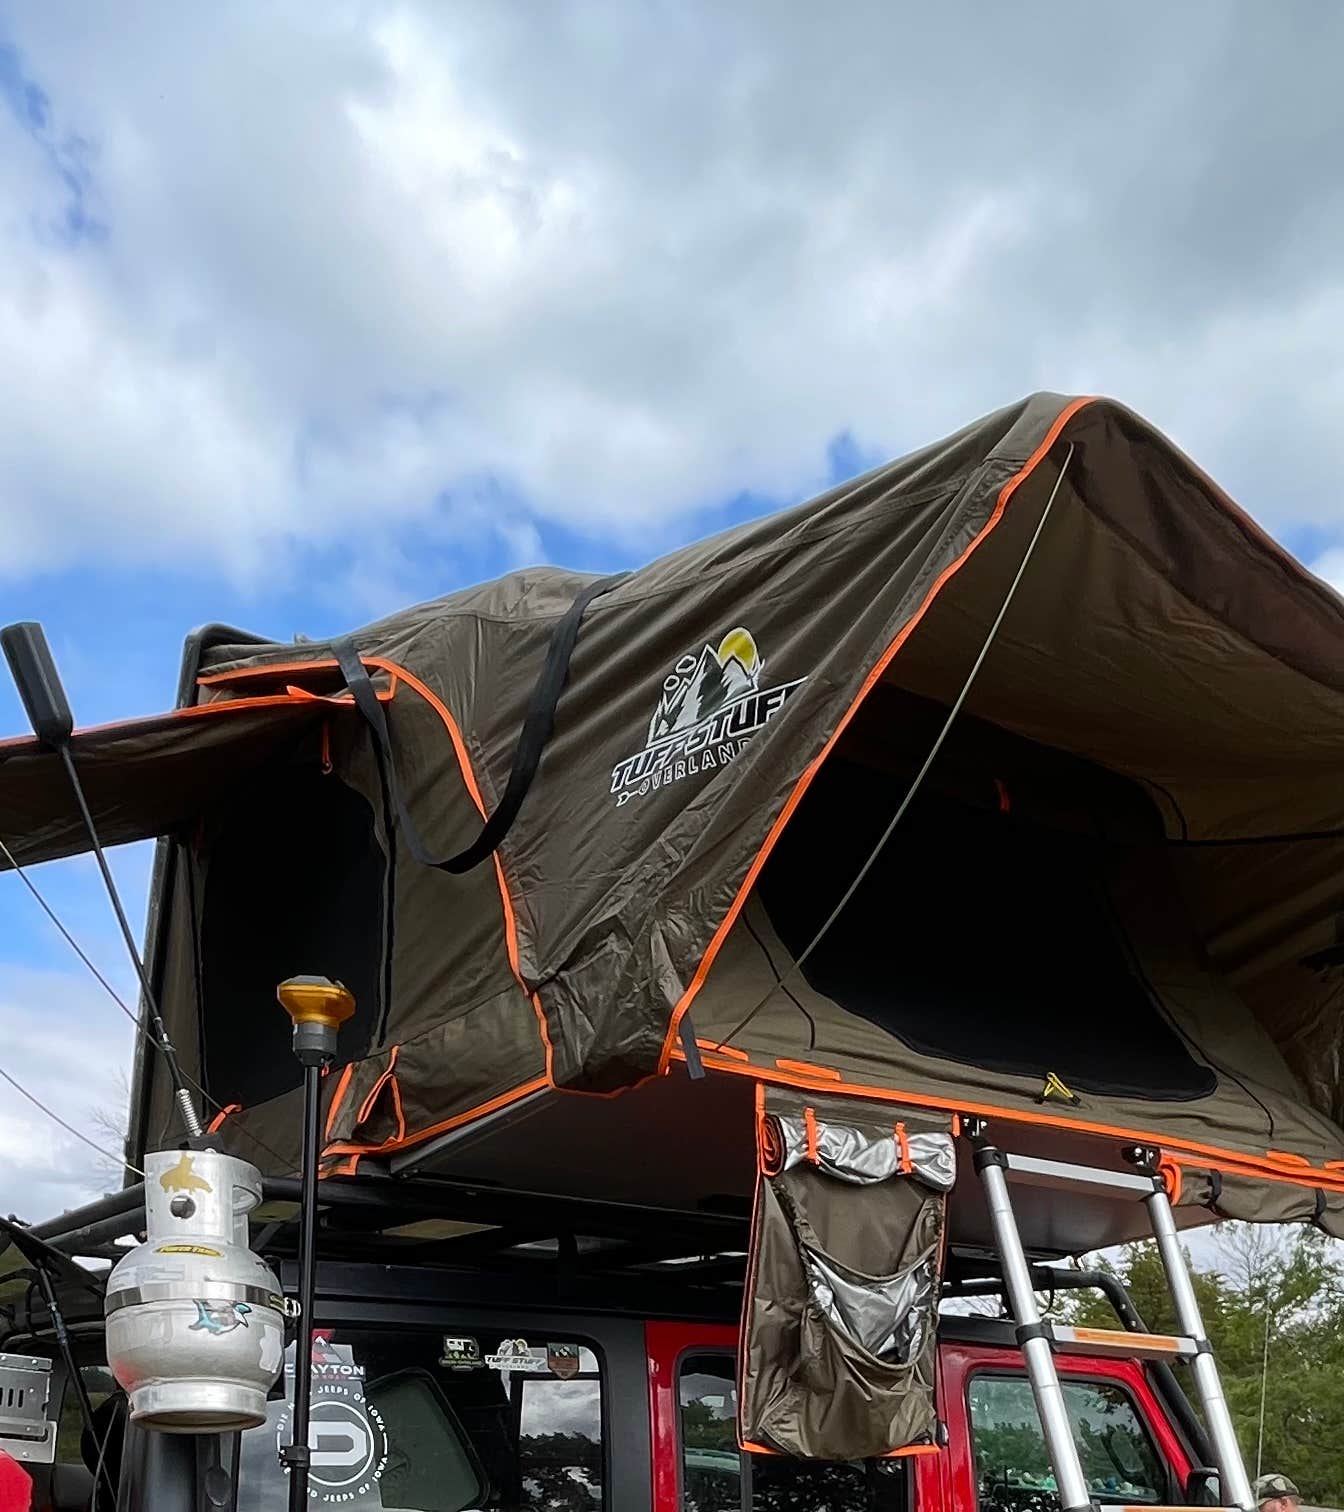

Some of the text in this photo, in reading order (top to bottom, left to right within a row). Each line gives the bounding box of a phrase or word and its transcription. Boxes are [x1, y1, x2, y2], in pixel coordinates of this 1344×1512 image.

[610, 737, 684, 793] TUFF
[284, 1364, 364, 1375] CAYTON
[317, 1385, 349, 1395] JEEPS
[353, 1393, 366, 1404] OF
[367, 1405, 385, 1431] IOWA
[323, 1457, 388, 1502] JEEPS OF IOWA
